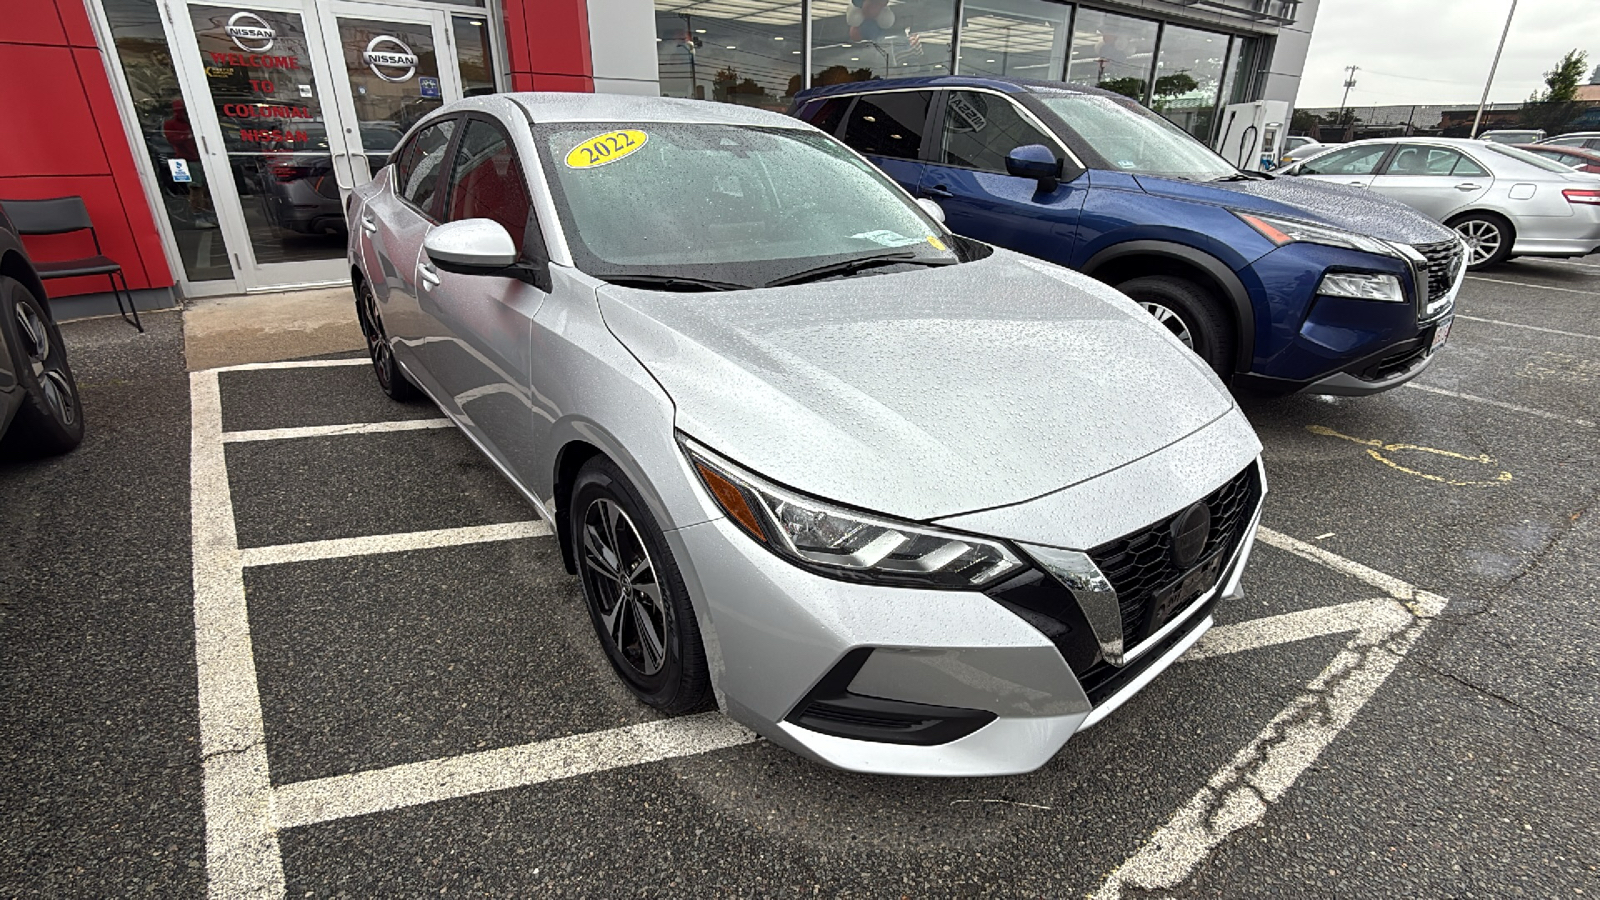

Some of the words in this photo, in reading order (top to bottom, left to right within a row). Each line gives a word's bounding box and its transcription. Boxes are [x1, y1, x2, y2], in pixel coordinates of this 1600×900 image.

[229, 27, 273, 38] NISSAN
[210, 52, 300, 70] WELCOME
[368, 54, 414, 65] NISSAN
[249, 79, 275, 94] TO
[223, 103, 313, 119] COLONIAL
[240, 129, 309, 143] NISSAN
[580, 132, 636, 164] 2022
